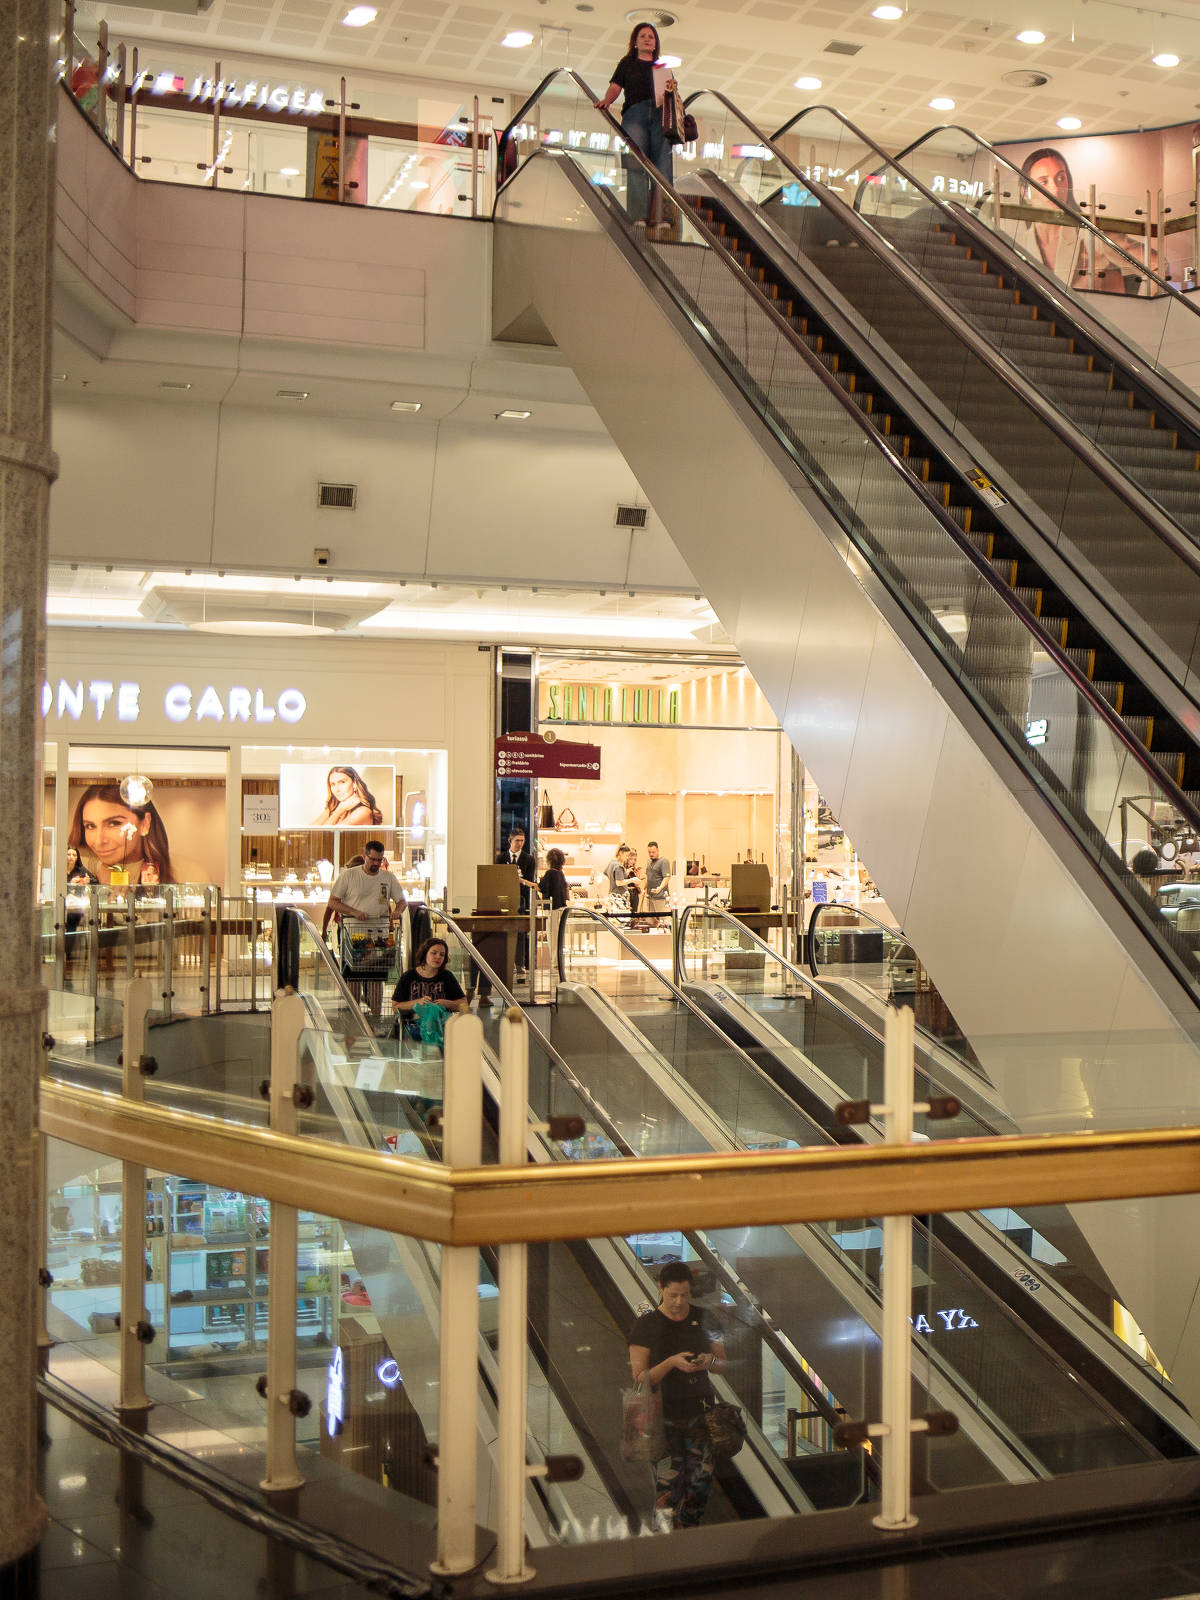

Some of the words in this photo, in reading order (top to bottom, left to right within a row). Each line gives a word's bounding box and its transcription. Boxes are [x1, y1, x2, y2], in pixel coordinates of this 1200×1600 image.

[164, 683, 307, 723] CARLO
[549, 685, 614, 721] SANTA
[622, 687, 680, 724] LOLLA
